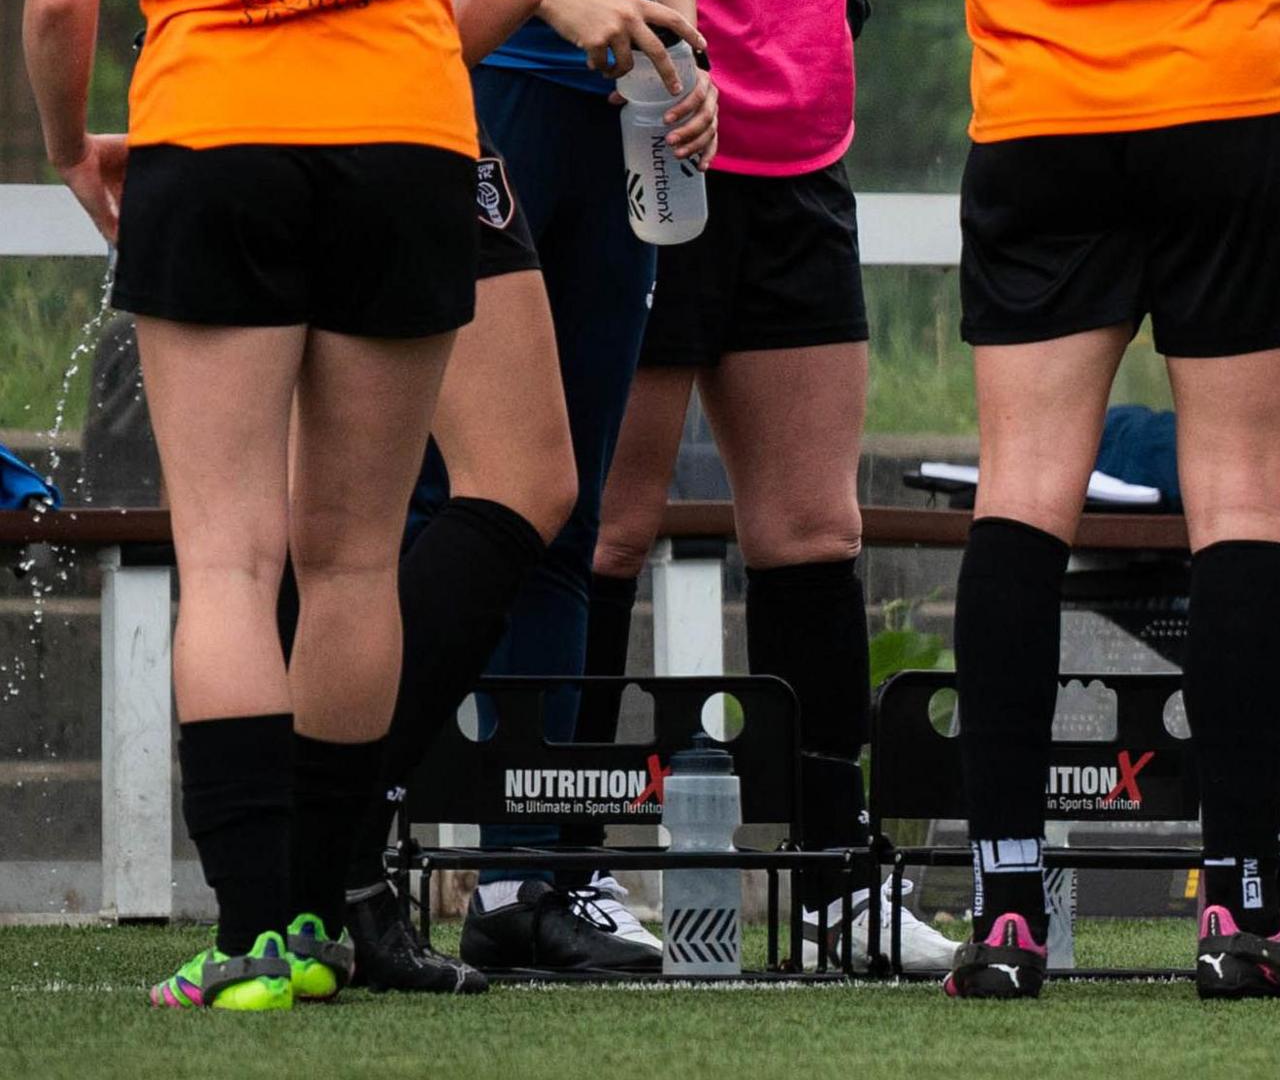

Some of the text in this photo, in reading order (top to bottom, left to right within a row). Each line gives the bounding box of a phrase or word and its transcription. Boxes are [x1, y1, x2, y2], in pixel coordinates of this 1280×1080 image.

[651, 134, 673, 224] NutritionX
[1045, 750, 1155, 803] ITIONX
[506, 800, 664, 816] The Ultimate in Sports Nutritio
[1047, 797, 1141, 812] in Sports Nutrition
